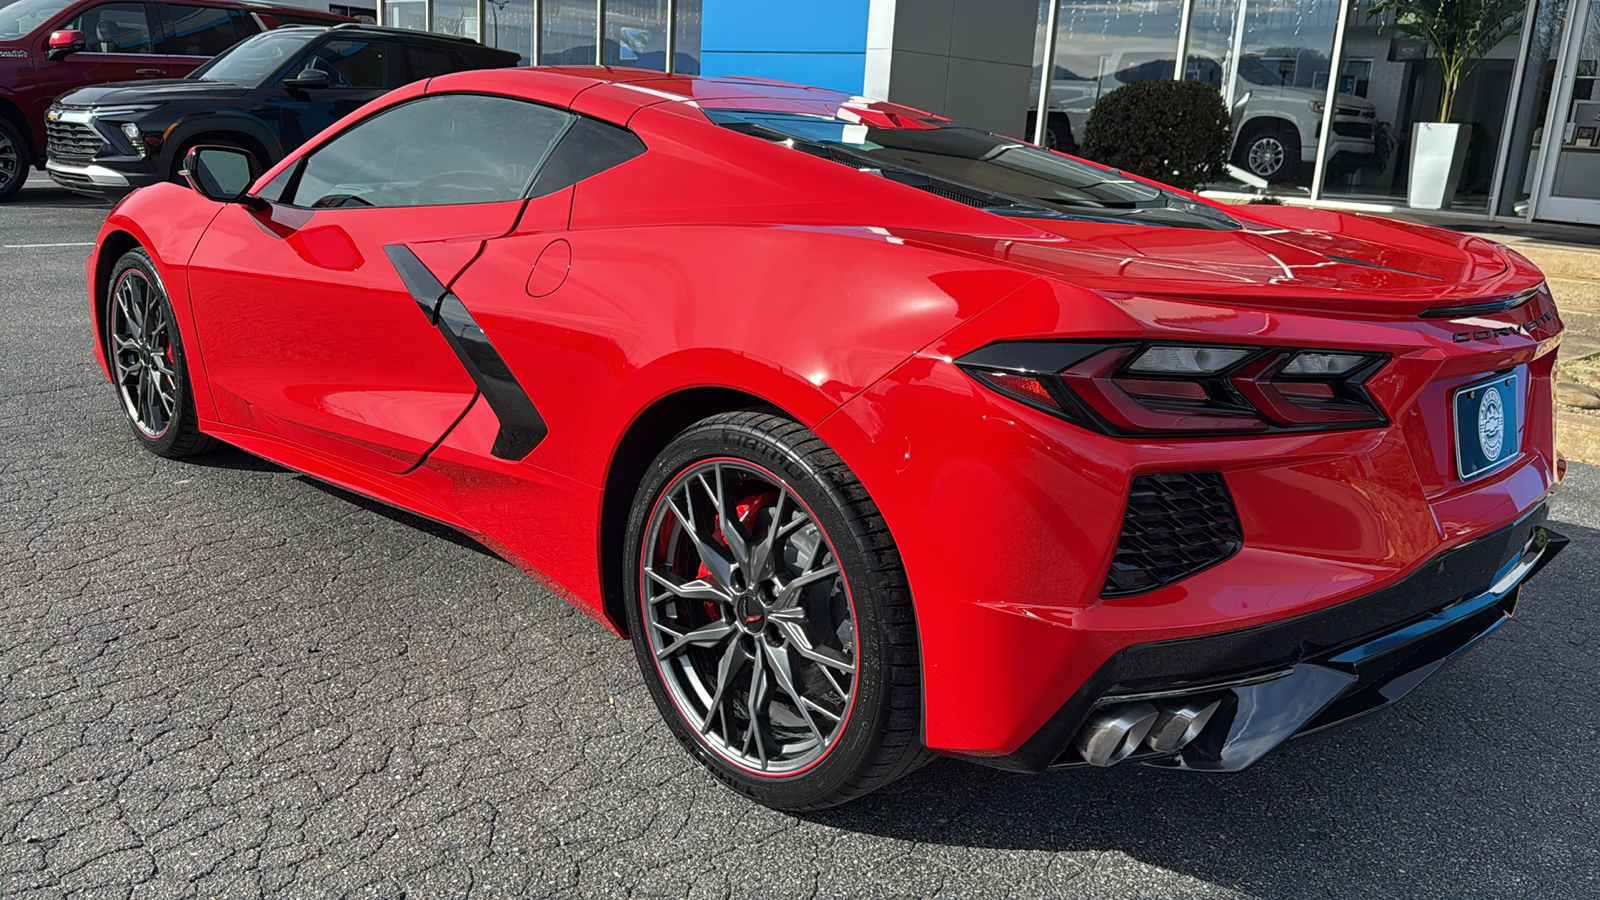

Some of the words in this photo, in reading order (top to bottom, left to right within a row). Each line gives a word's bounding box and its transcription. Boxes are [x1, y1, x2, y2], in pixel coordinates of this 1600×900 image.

[1452, 311, 1553, 342] CORVETTE
[726, 433, 800, 479] MICHELIN
[857, 574, 876, 622] SEASON
